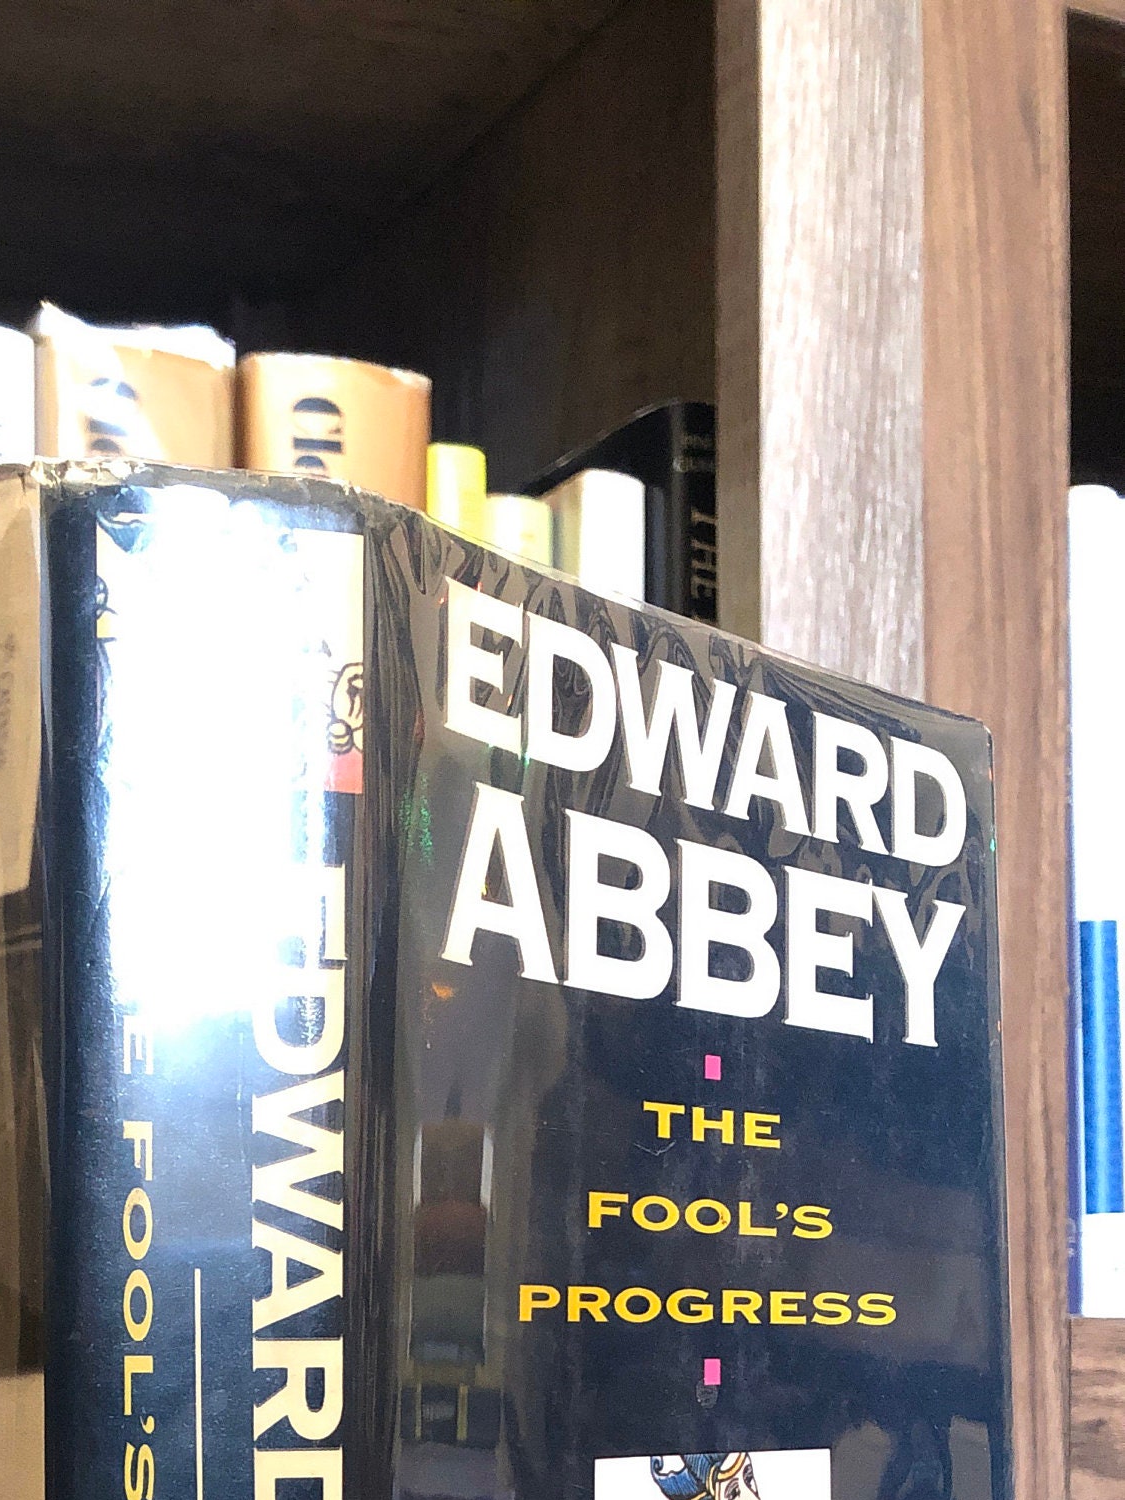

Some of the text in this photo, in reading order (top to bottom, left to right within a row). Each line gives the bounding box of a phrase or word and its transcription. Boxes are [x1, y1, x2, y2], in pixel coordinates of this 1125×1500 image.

[444, 576, 968, 868] EDWARD
[439, 782, 967, 1048] ABBEY
[642, 1100, 781, 1149] THE
[586, 1192, 834, 1239] FOOL'S
[518, 1284, 898, 1326] PROGRESS
